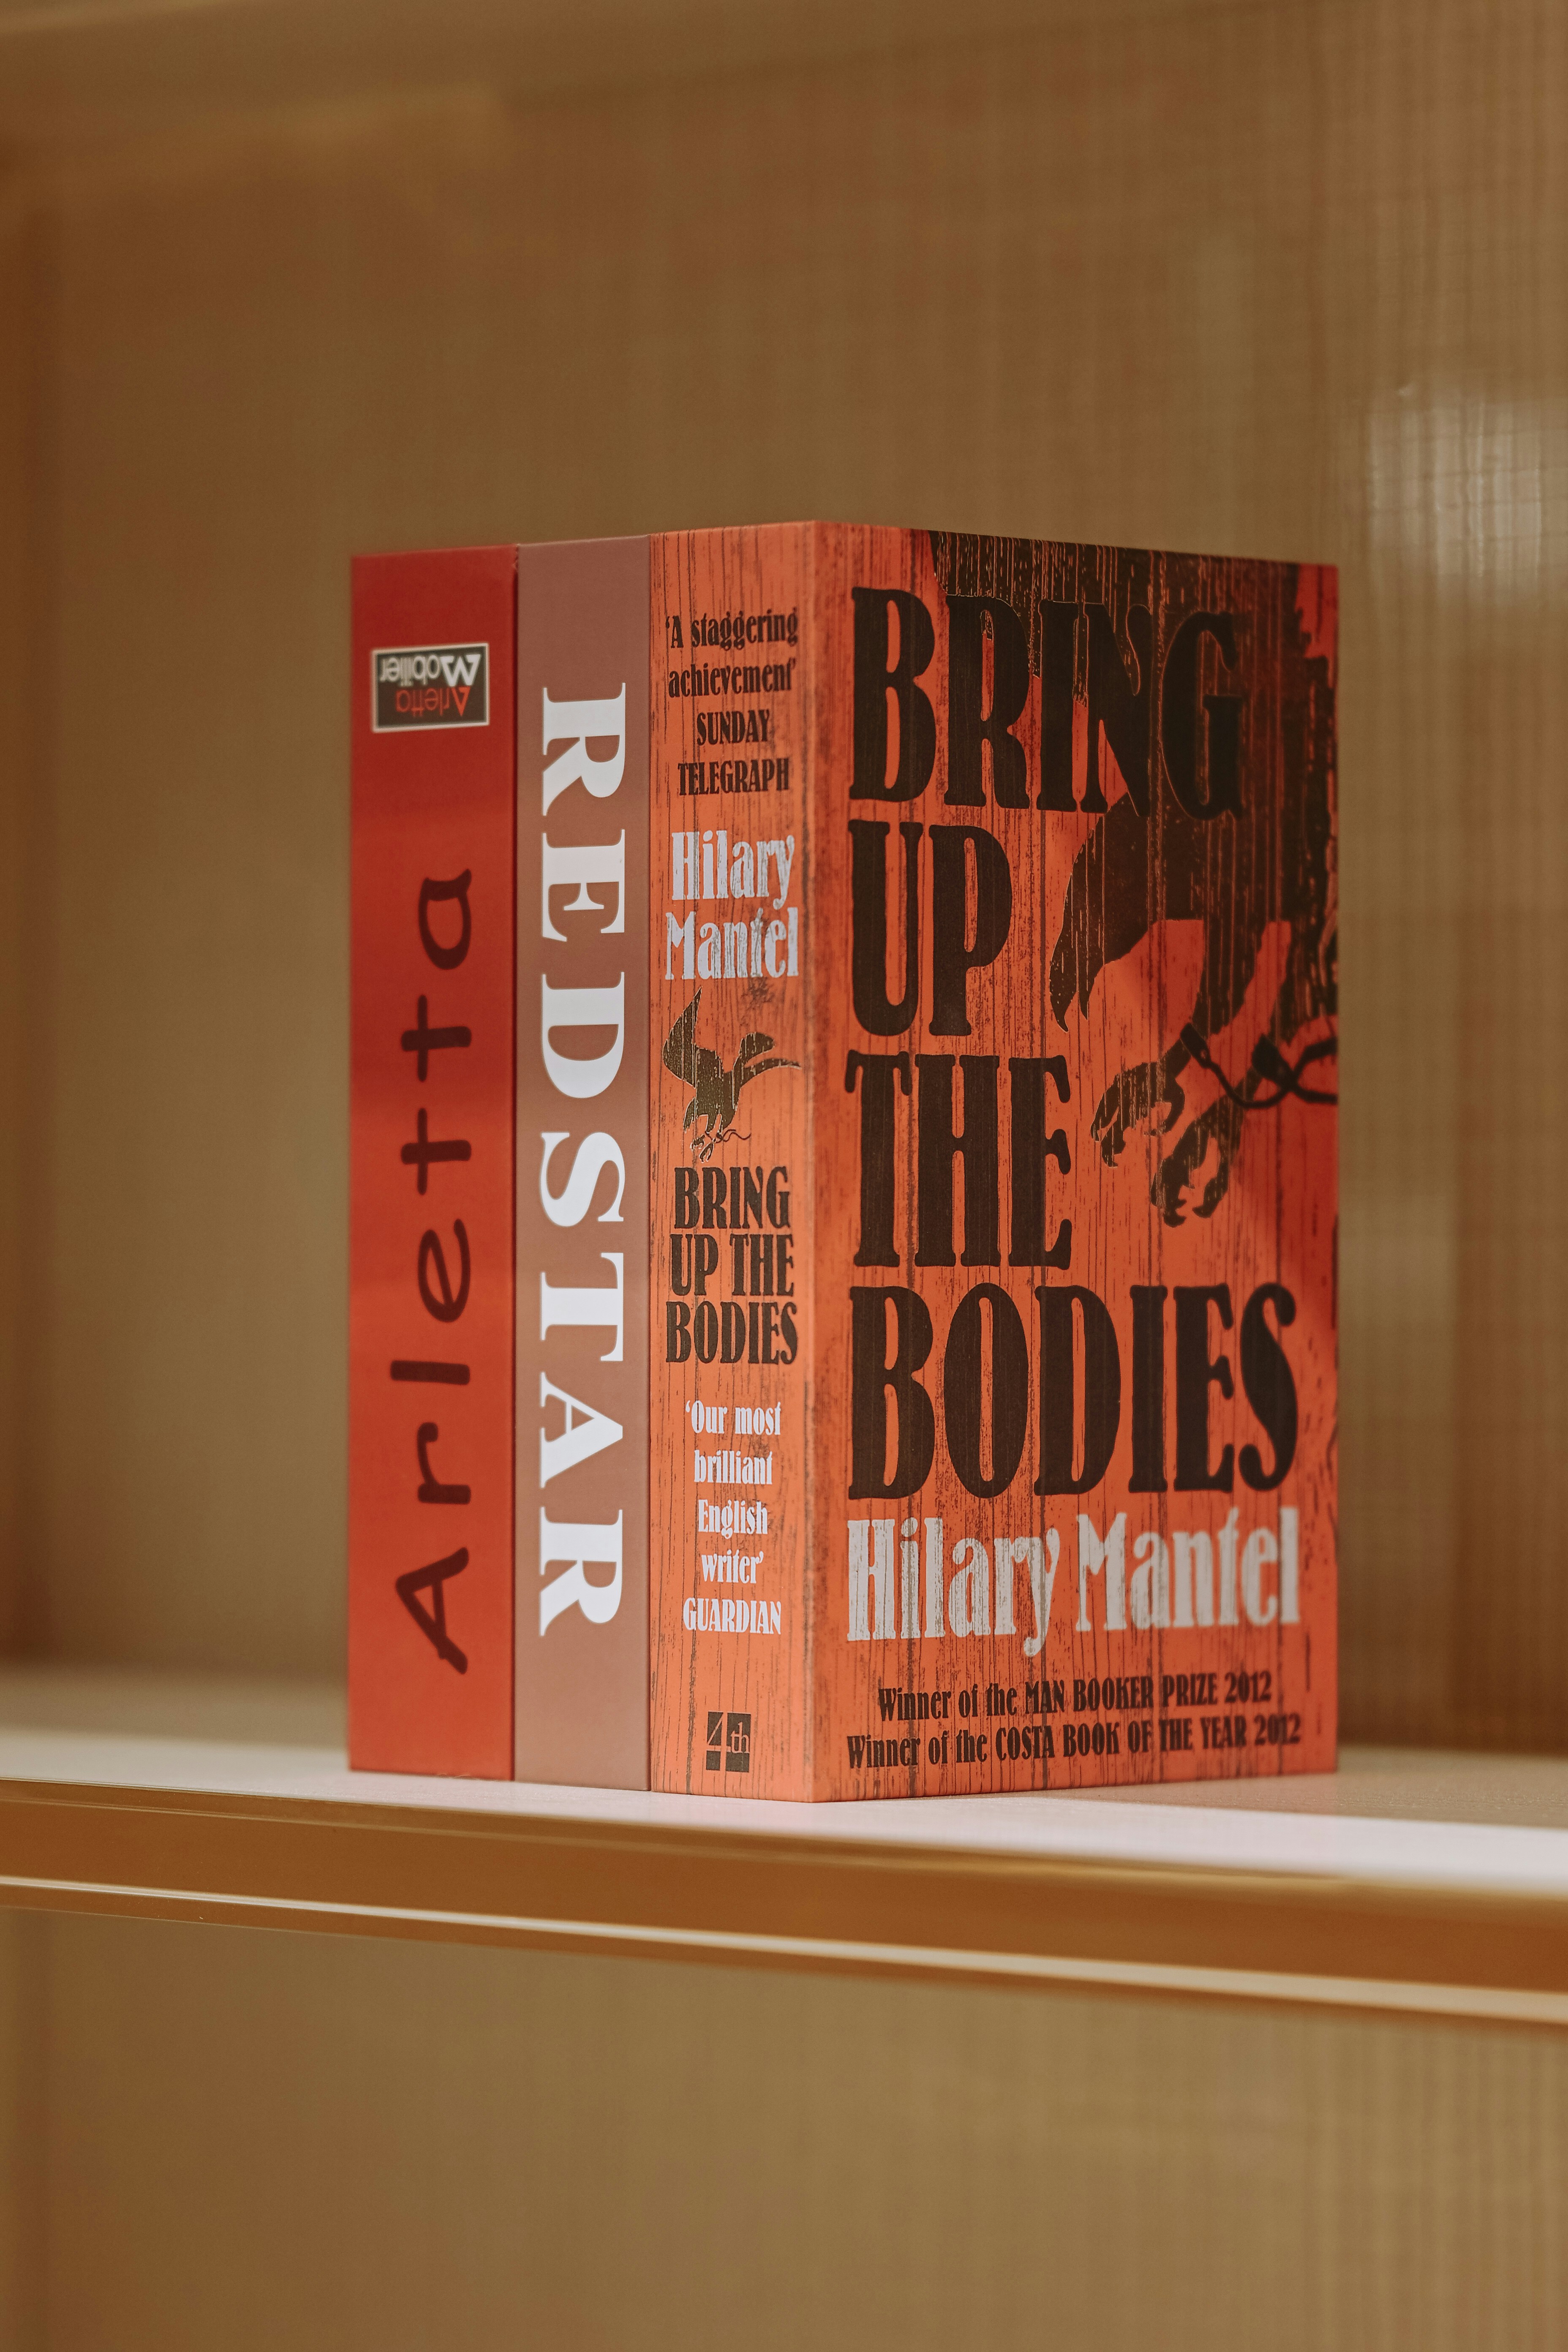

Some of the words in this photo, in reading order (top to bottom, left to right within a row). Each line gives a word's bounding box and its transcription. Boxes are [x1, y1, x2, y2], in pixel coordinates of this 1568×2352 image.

[691, 607, 798, 651] staggering
[668, 657, 797, 698] achievement’
[849, 586, 1244, 821] BRING
[697, 709, 770, 746] SUNDAY
[677, 758, 789, 796] TELEGRAPH
[672, 830, 795, 909] Hilary
[665, 906, 799, 980] Mantel
[847, 819, 1013, 1037] UP
[539, 682, 626, 1636] REDSTAR
[845, 1049, 1072, 1268] THE
[674, 1166, 790, 1229] BRING
[389, 868, 472, 1675] Arletta
[670, 1233, 719, 1296] UP
[730, 1233, 794, 1296] THE
[666, 1301, 798, 1365] BODIES
[735, 1401, 781, 1435] most
[848, 1282, 1298, 1500] BODIES
[694, 1449, 773, 1485] brilliant
[697, 1499, 768, 1538] English
[847, 1516, 1060, 1657] Hilary
[1075, 1505, 1301, 1632] Mantel
[683, 1598, 782, 1635] GUARDIAN
[878, 1687, 951, 1721] Winner
[958, 1683, 978, 1718] of
[986, 1683, 1017, 1716] the
[1025, 1680, 1064, 1713] MAN
[1073, 1676, 1154, 1712] BOOKER
[1162, 1673, 1218, 1707] PRIZE
[1225, 1670, 1272, 1704] 2012
[706, 1711, 751, 1773] 4th
[847, 1734, 921, 1769] Winner
[928, 1730, 949, 1764] of
[956, 1729, 988, 1763] the
[996, 1725, 1055, 1760] COSTA
[1063, 1721, 1119, 1757] BOOK
[1127, 1718, 1153, 1753] OF
[1159, 1718, 1193, 1752] THE
[1200, 1715, 1247, 1749] YEAR
[1254, 1712, 1301, 1746] 2012
